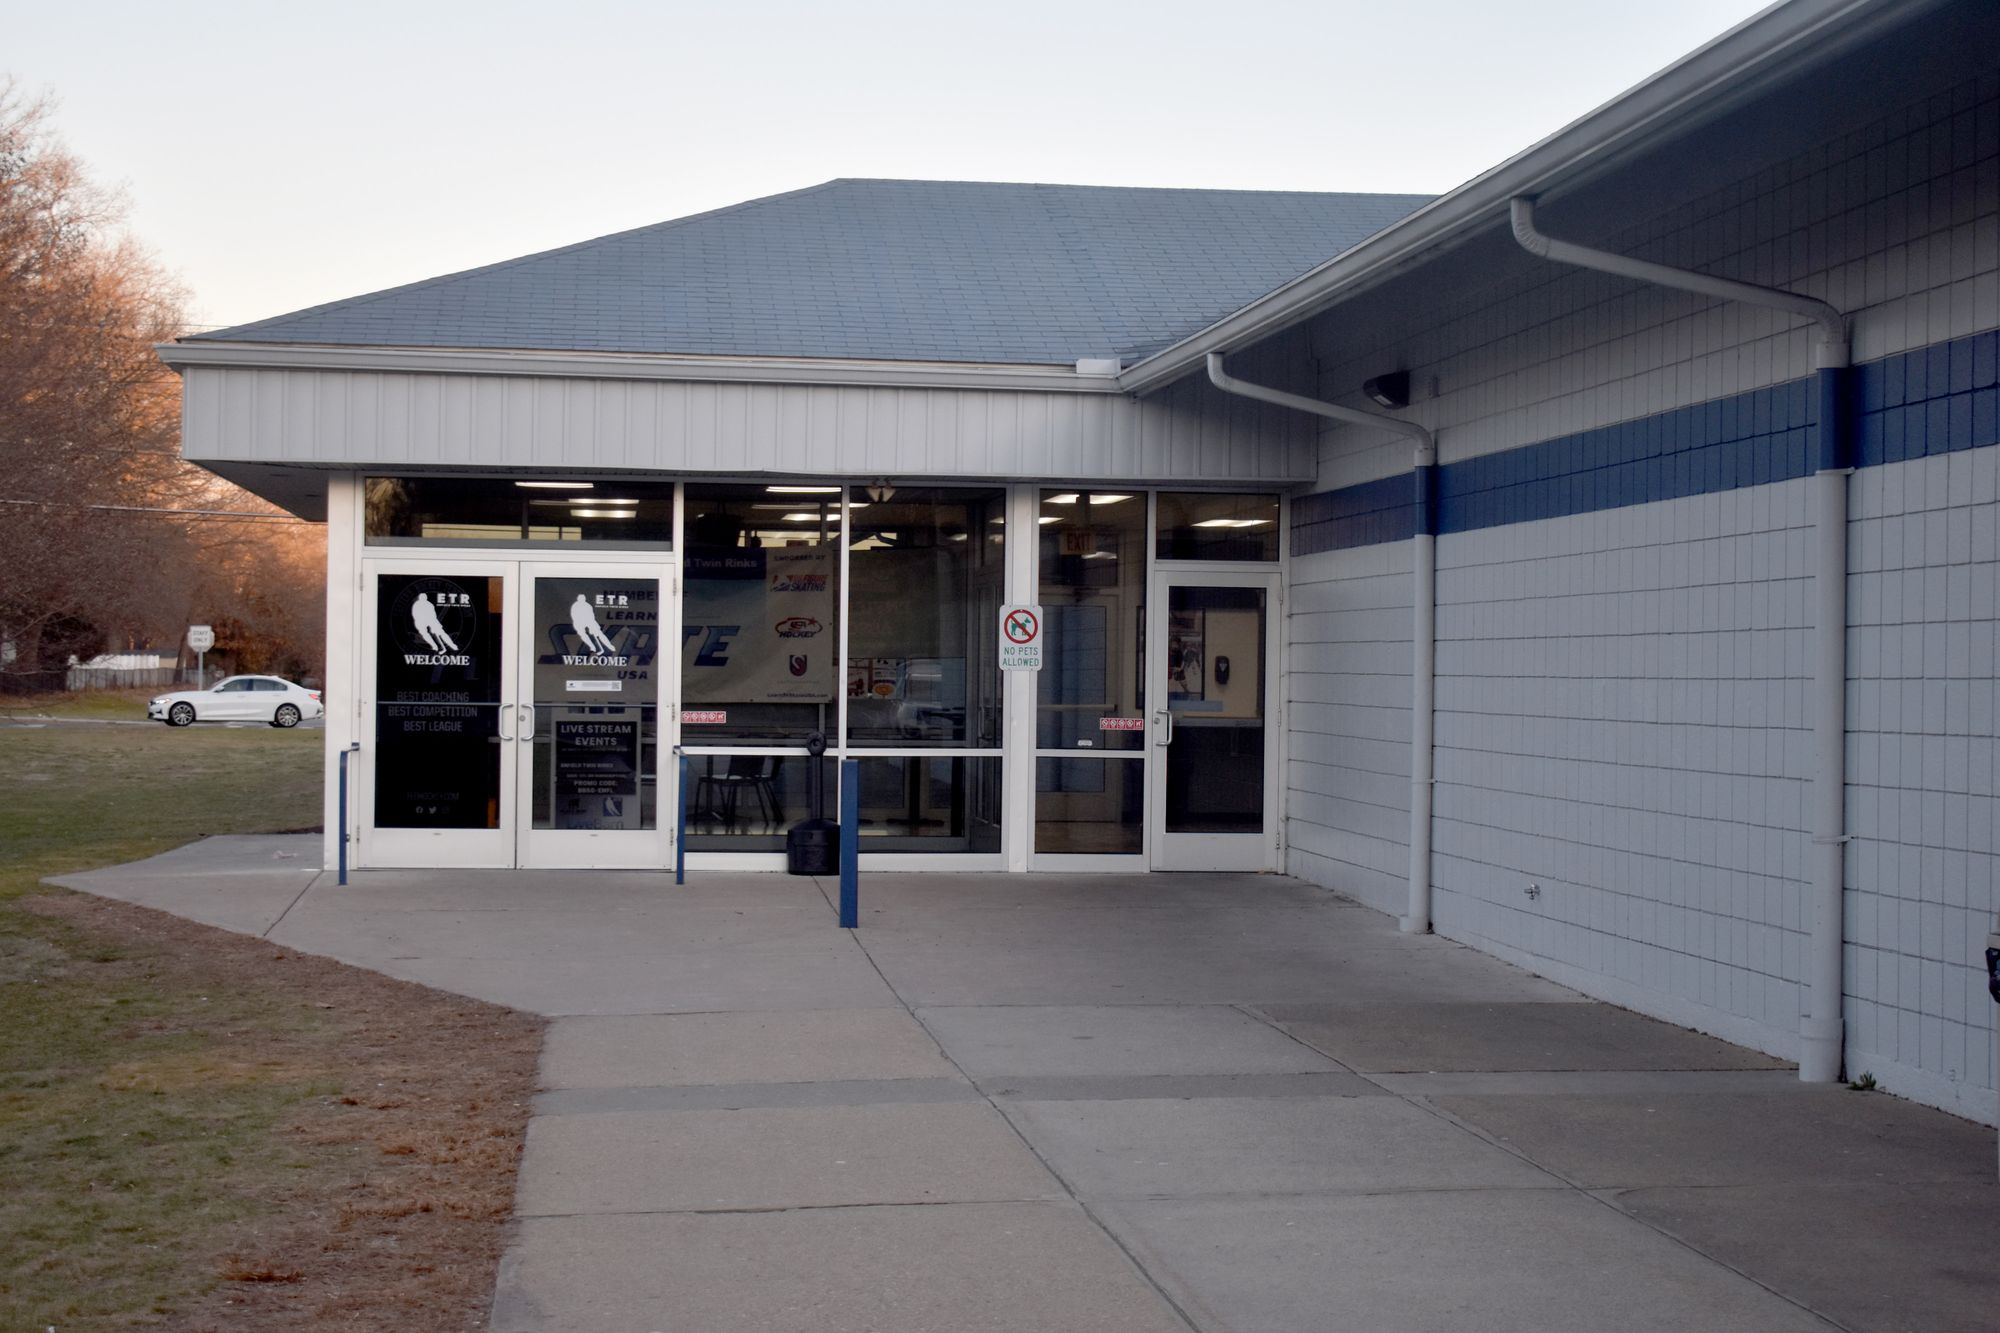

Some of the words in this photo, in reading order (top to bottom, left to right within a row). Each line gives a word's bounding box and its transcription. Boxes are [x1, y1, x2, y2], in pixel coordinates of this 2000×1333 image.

[695, 558, 722, 568] Twin
[725, 558, 757, 568] Rinks
[436, 592, 471, 604] ETR
[596, 594, 628, 606] ETR
[604, 590, 658, 601] MEMBE
[606, 611, 657, 621] LEARN
[1004, 647, 1015, 656] NO
[1018, 647, 1039, 656] PETS
[404, 654, 471, 666] WELCOME
[562, 655, 628, 667] WELCOME
[1002, 657, 1040, 667] ALLOWED
[617, 670, 648, 680] USA
[397, 691, 419, 702] BEST
[422, 691, 470, 702] COACHING
[388, 706, 412, 717] BEST
[413, 706, 478, 718] COMPETITION
[404, 721, 426, 732] BEST
[428, 720, 463, 732] LEAGUE
[561, 725, 584, 734] LIVE
[586, 725, 632, 734] STREAM
[575, 737, 617, 746] EVENTS
